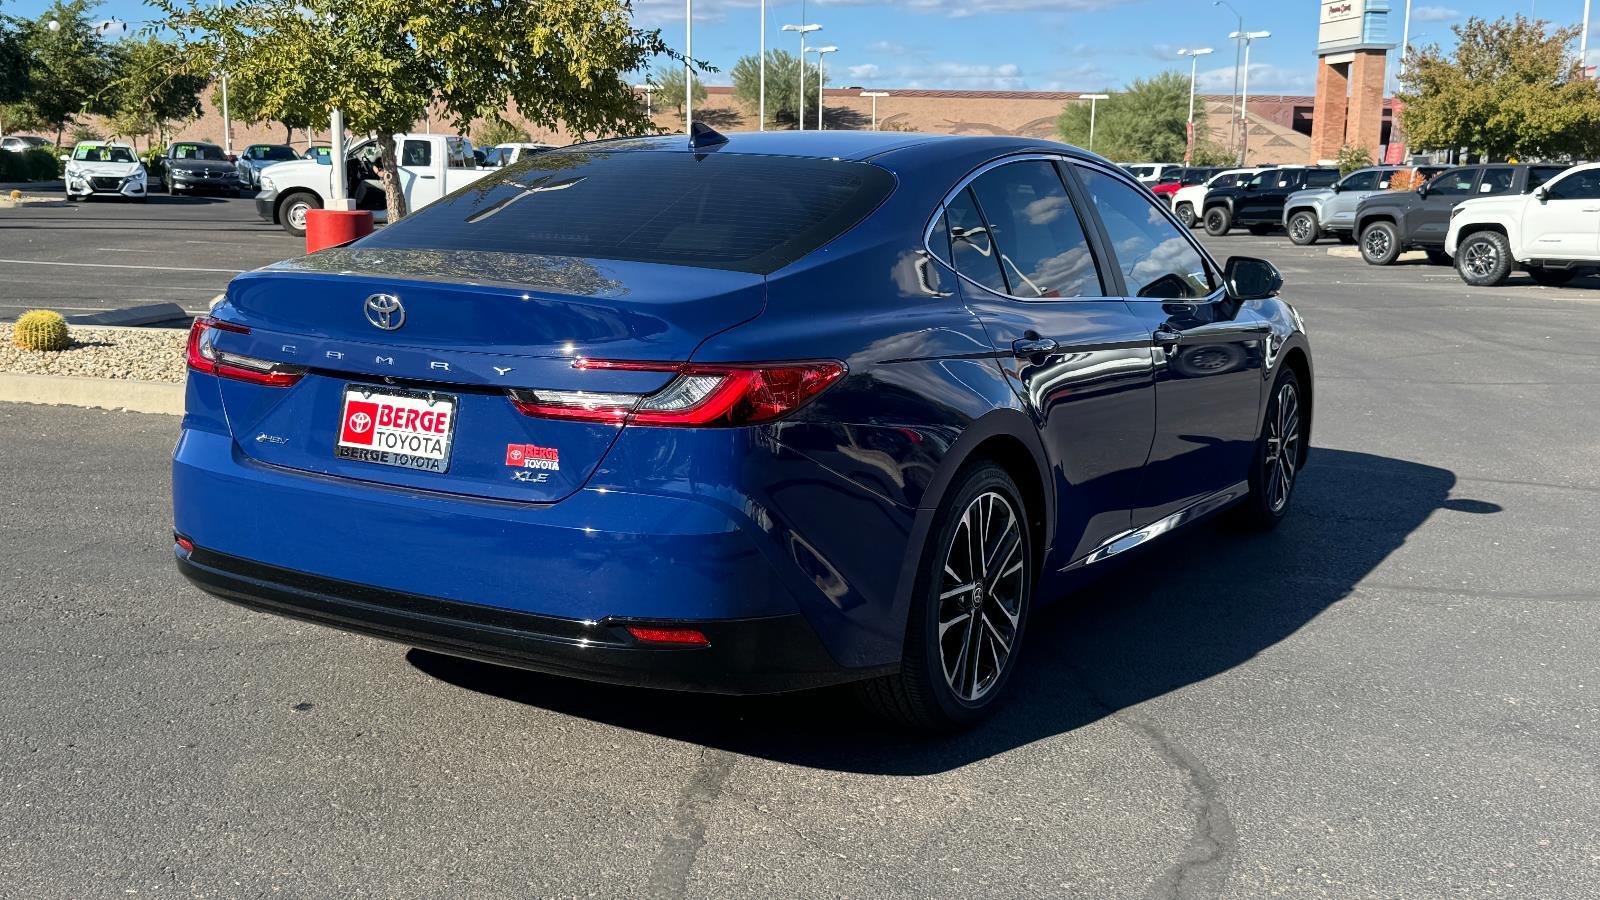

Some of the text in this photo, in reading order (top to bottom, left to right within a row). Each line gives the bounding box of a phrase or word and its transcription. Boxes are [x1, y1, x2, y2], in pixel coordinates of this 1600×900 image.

[281, 344, 515, 376] CAMRY
[379, 404, 447, 434] BERGE
[376, 431, 443, 455] TOYOTA
[524, 444, 559, 460] BERGE
[340, 447, 441, 471] BERGE TOYOTA
[524, 458, 560, 471] TOYOTA
[511, 470, 551, 483] XLE
